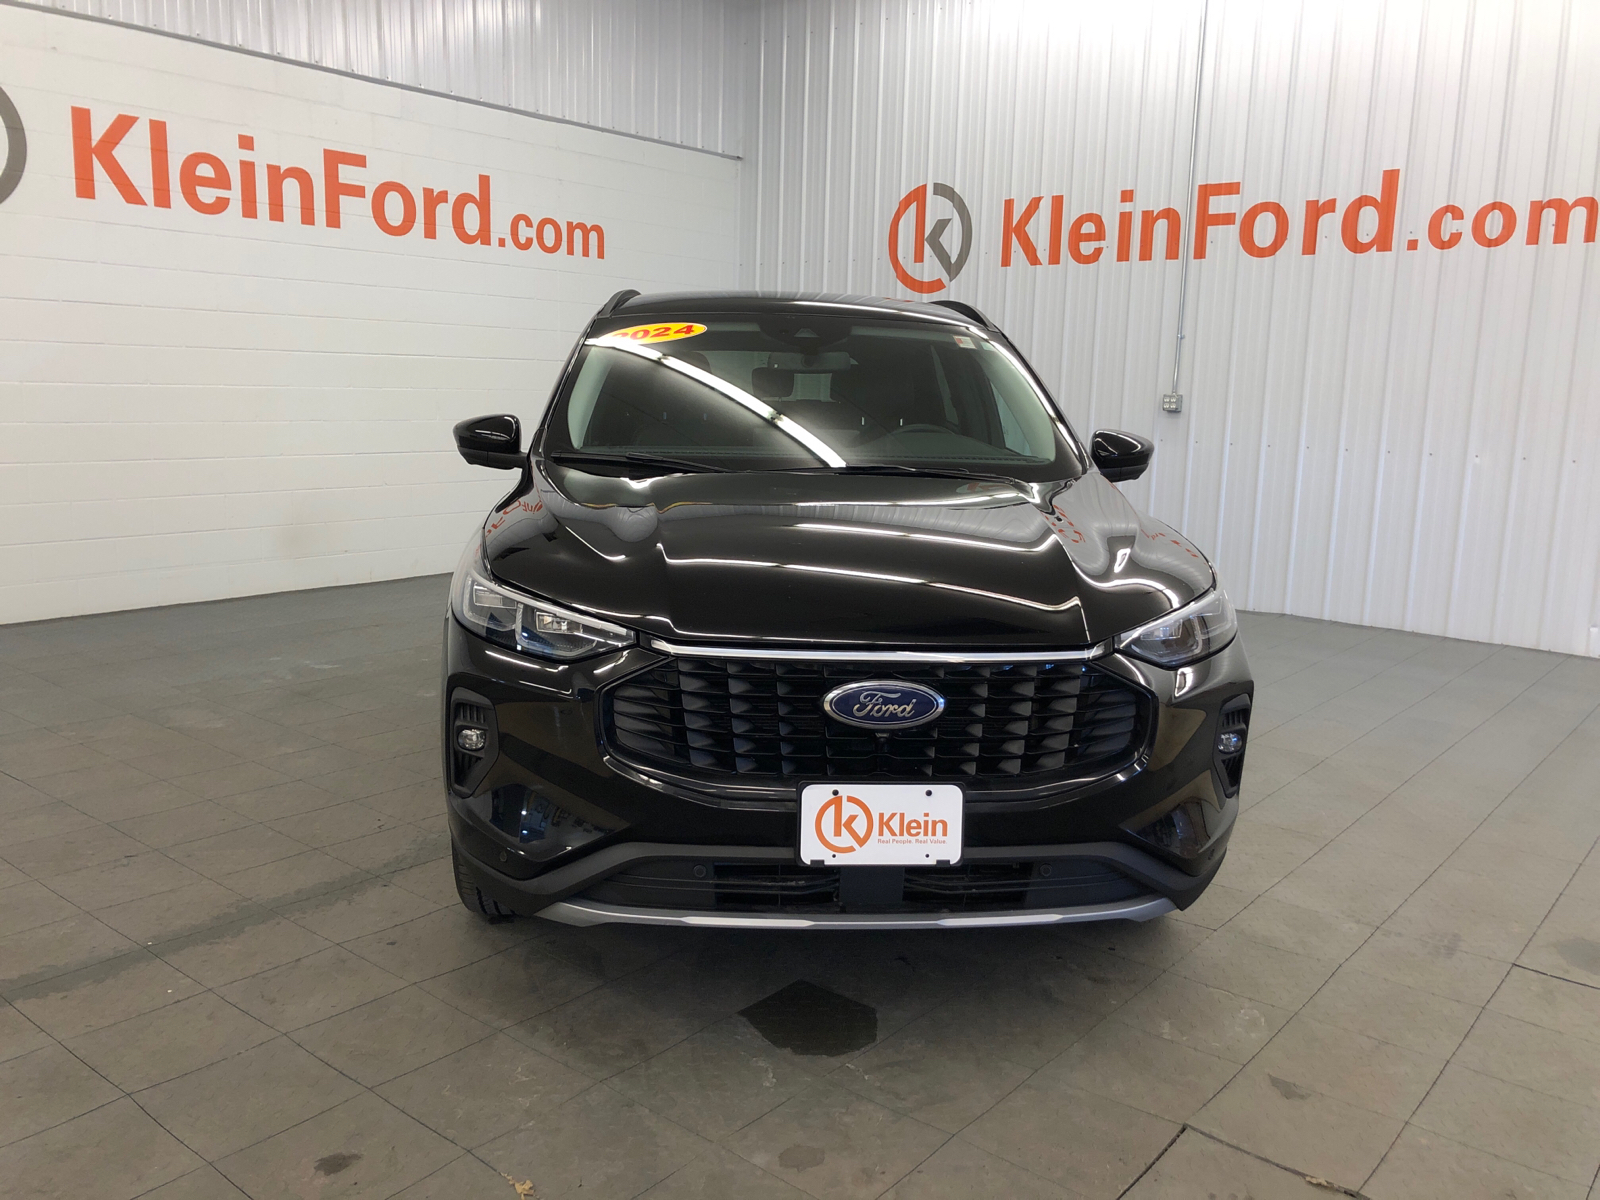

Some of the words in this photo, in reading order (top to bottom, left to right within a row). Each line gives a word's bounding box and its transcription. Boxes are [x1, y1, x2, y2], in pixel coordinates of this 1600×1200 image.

[70, 105, 606, 260] KleinFord.com
[1000, 168, 1599, 268] KleinFord.com
[853, 690, 917, 718] Ford
[878, 812, 949, 837] Klein
[892, 838, 914, 846] People.
